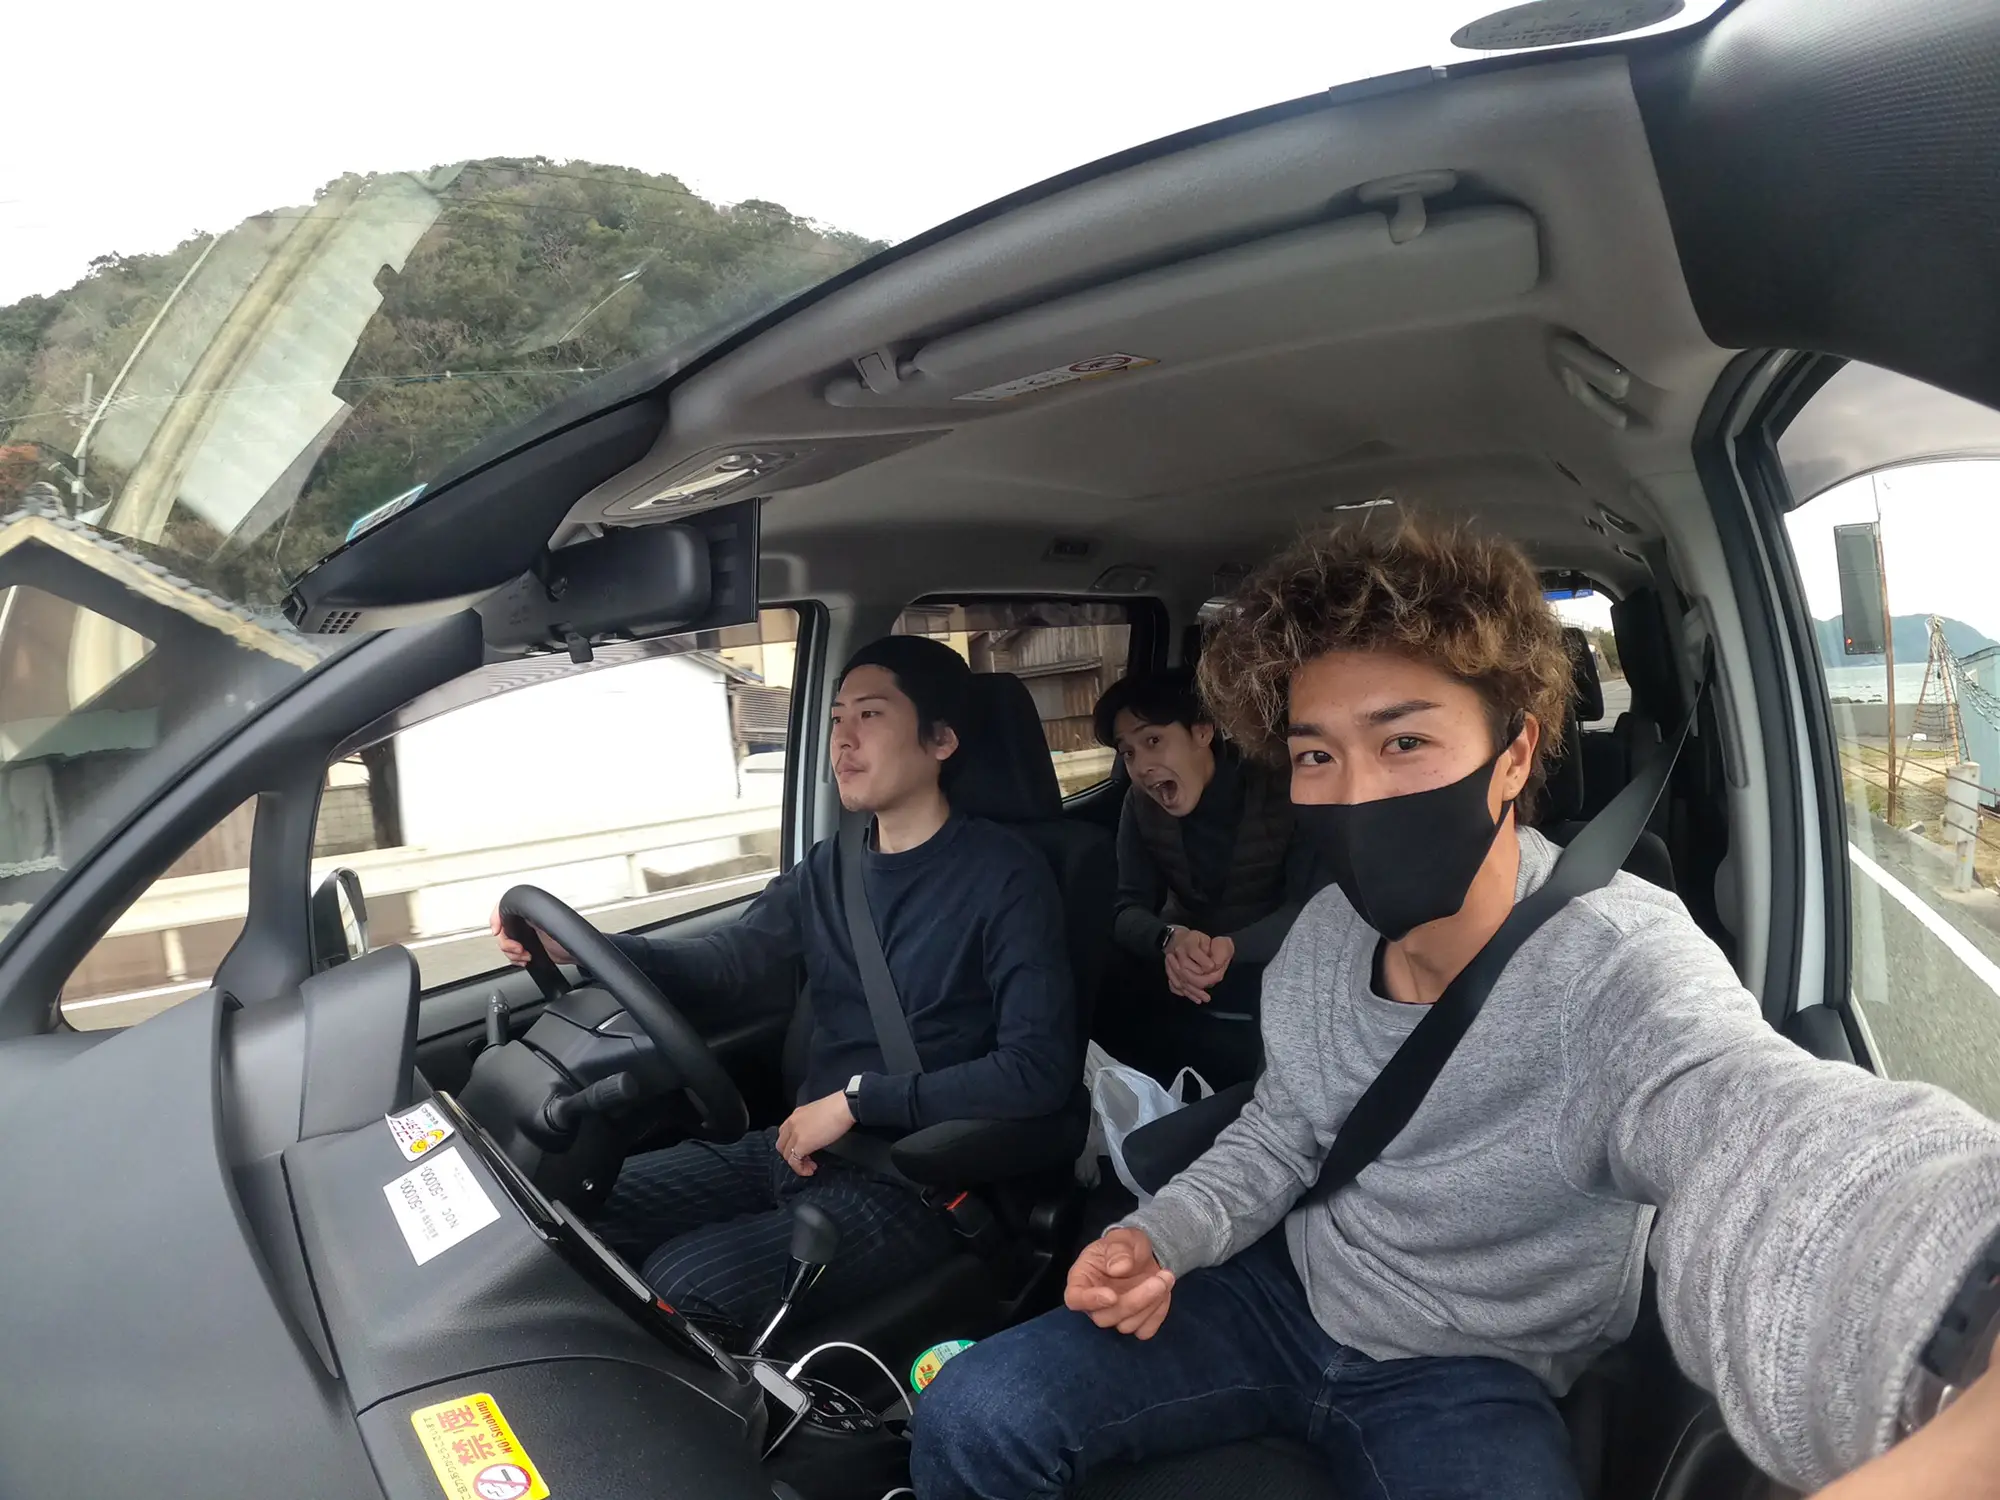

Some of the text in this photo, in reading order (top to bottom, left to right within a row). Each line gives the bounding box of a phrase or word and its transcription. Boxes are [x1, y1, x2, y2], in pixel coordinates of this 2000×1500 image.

[442, 1208, 459, 1229] NOC
[436, 1405, 496, 1466] 禁煙
[476, 1401, 504, 1438] Smoking
